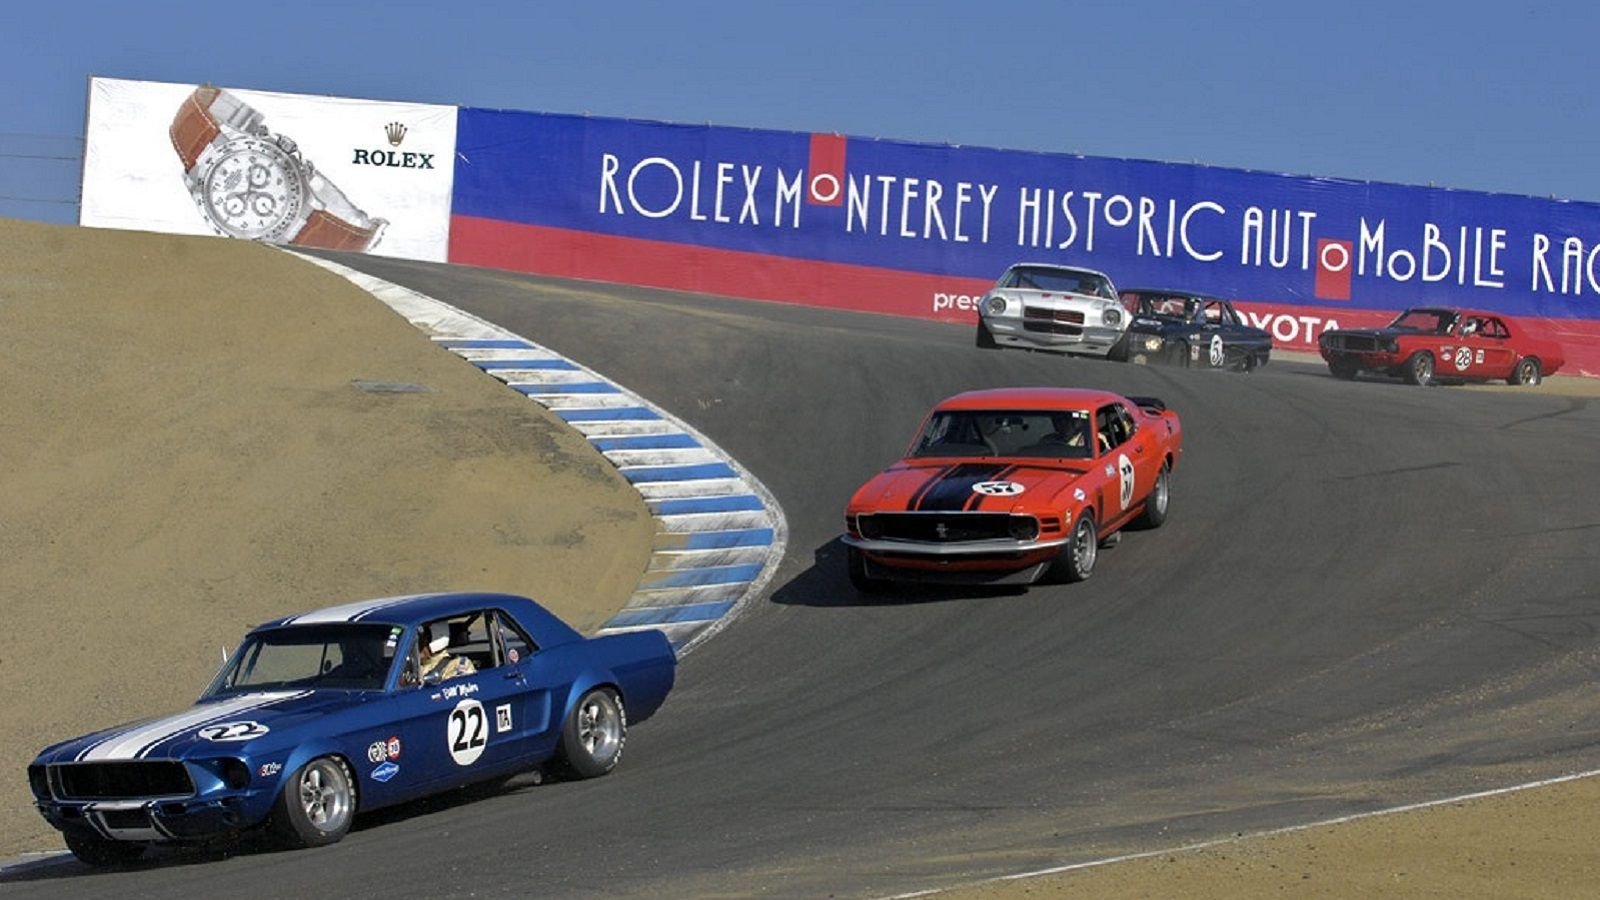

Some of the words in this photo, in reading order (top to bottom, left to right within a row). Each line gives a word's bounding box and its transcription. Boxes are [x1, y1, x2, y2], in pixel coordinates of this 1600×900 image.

[352, 149, 435, 169] ROLEX
[600, 153, 762, 225] ROLEX
[775, 168, 998, 243] MONTEREY
[1018, 187, 1226, 261] HISTORIC
[1241, 206, 1506, 288] AUTOMOBILE
[1457, 350, 1470, 366] 28
[204, 723, 265, 739] 22
[453, 706, 485, 752] 22
